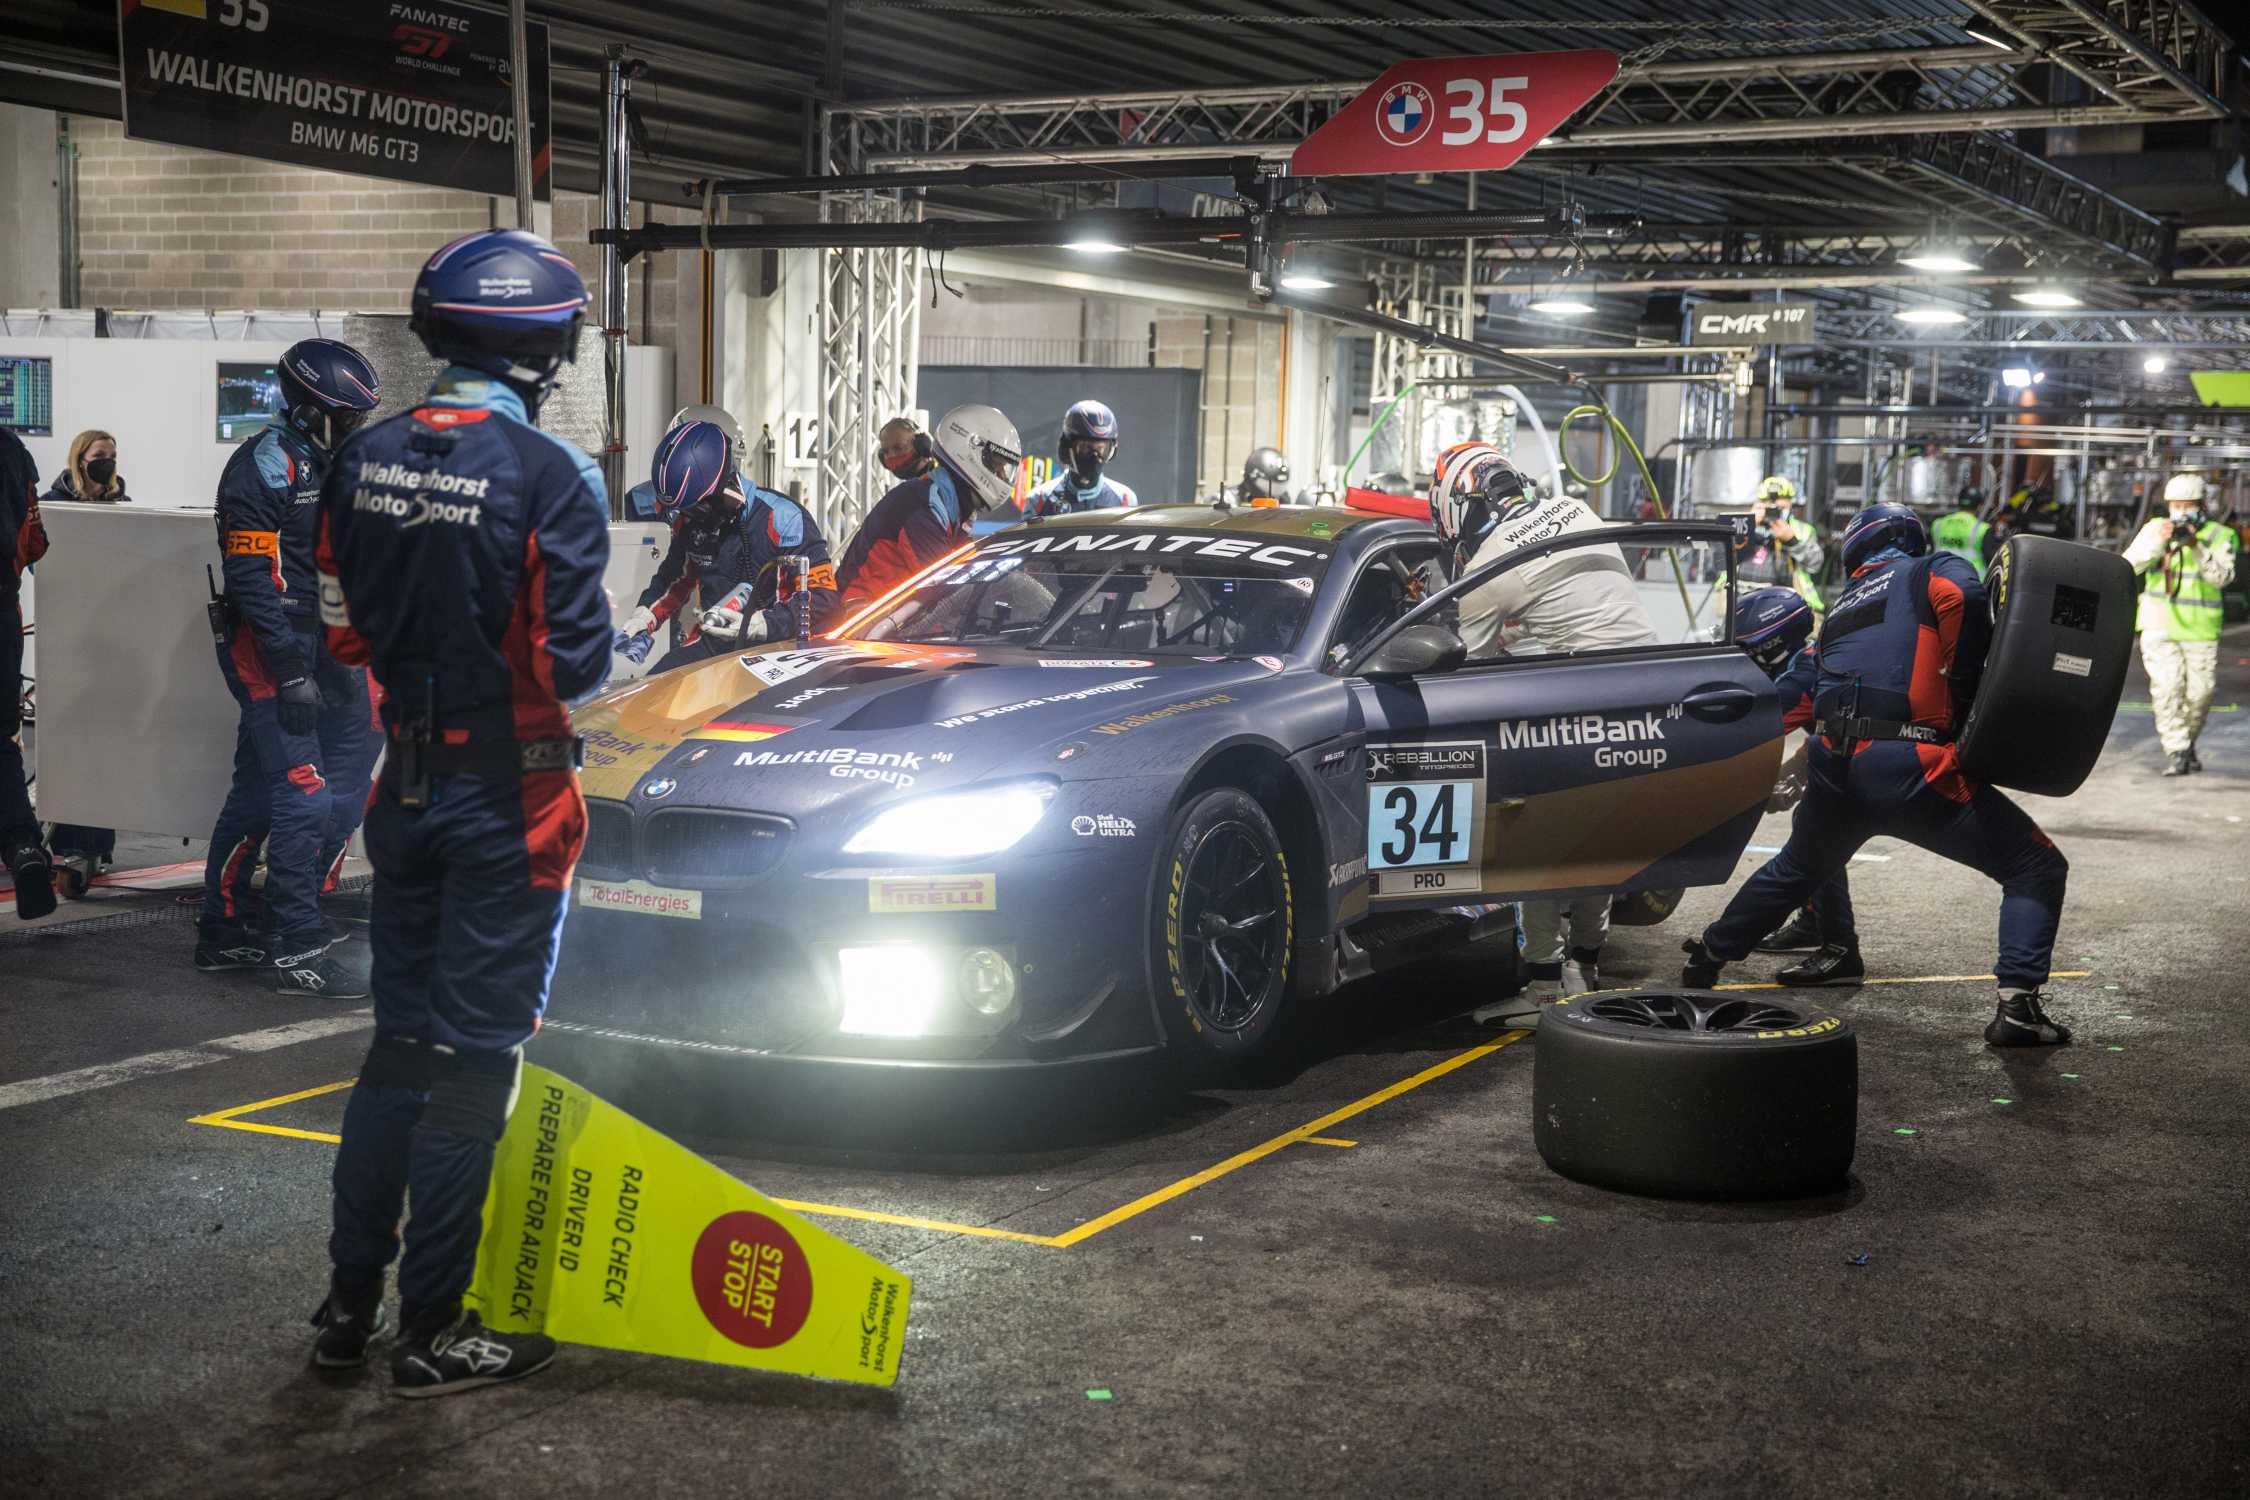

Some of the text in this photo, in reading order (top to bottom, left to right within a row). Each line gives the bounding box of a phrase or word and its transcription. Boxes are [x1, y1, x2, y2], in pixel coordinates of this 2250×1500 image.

[218, 0, 270, 32] 35
[389, 3, 470, 33] FANATEC
[147, 48, 364, 118] WALKENHORST
[395, 55, 461, 77] WORLD CHALLENGE
[1385, 85, 1428, 104] BMW
[1441, 76, 1529, 145] 35
[290, 121, 420, 163] BMW M6 GT3
[1699, 313, 1770, 334] CMR
[789, 417, 818, 459] 12
[359, 461, 490, 499] Walkenhorst
[977, 533, 1318, 567] FANATEC
[934, 712, 978, 729] We
[978, 698, 1045, 719] stand
[1090, 694, 1234, 736] Walkenhorst
[1500, 712, 1665, 752] MultiBank
[733, 748, 923, 770] MultiBank
[1384, 750, 1475, 765] REBELLION
[1594, 743, 1668, 769] Group
[829, 764, 915, 790] Group
[1100, 828, 1136, 837] ULTRA
[1381, 783, 1459, 866] 34
[589, 885, 690, 912] TotalEnergies
[1414, 872, 1446, 889] PRO
[509, 1084, 563, 1322] PREPARE FOR AIRJACK
[559, 1167, 593, 1273] DRIVER ID
[603, 1164, 643, 1309] RADIO CHECK
[722, 1239, 752, 1309] STOP
[751, 1244, 783, 1329] START
[859, 1276, 884, 1368] MotorSport
[873, 1283, 899, 1373] Walkenhorst
